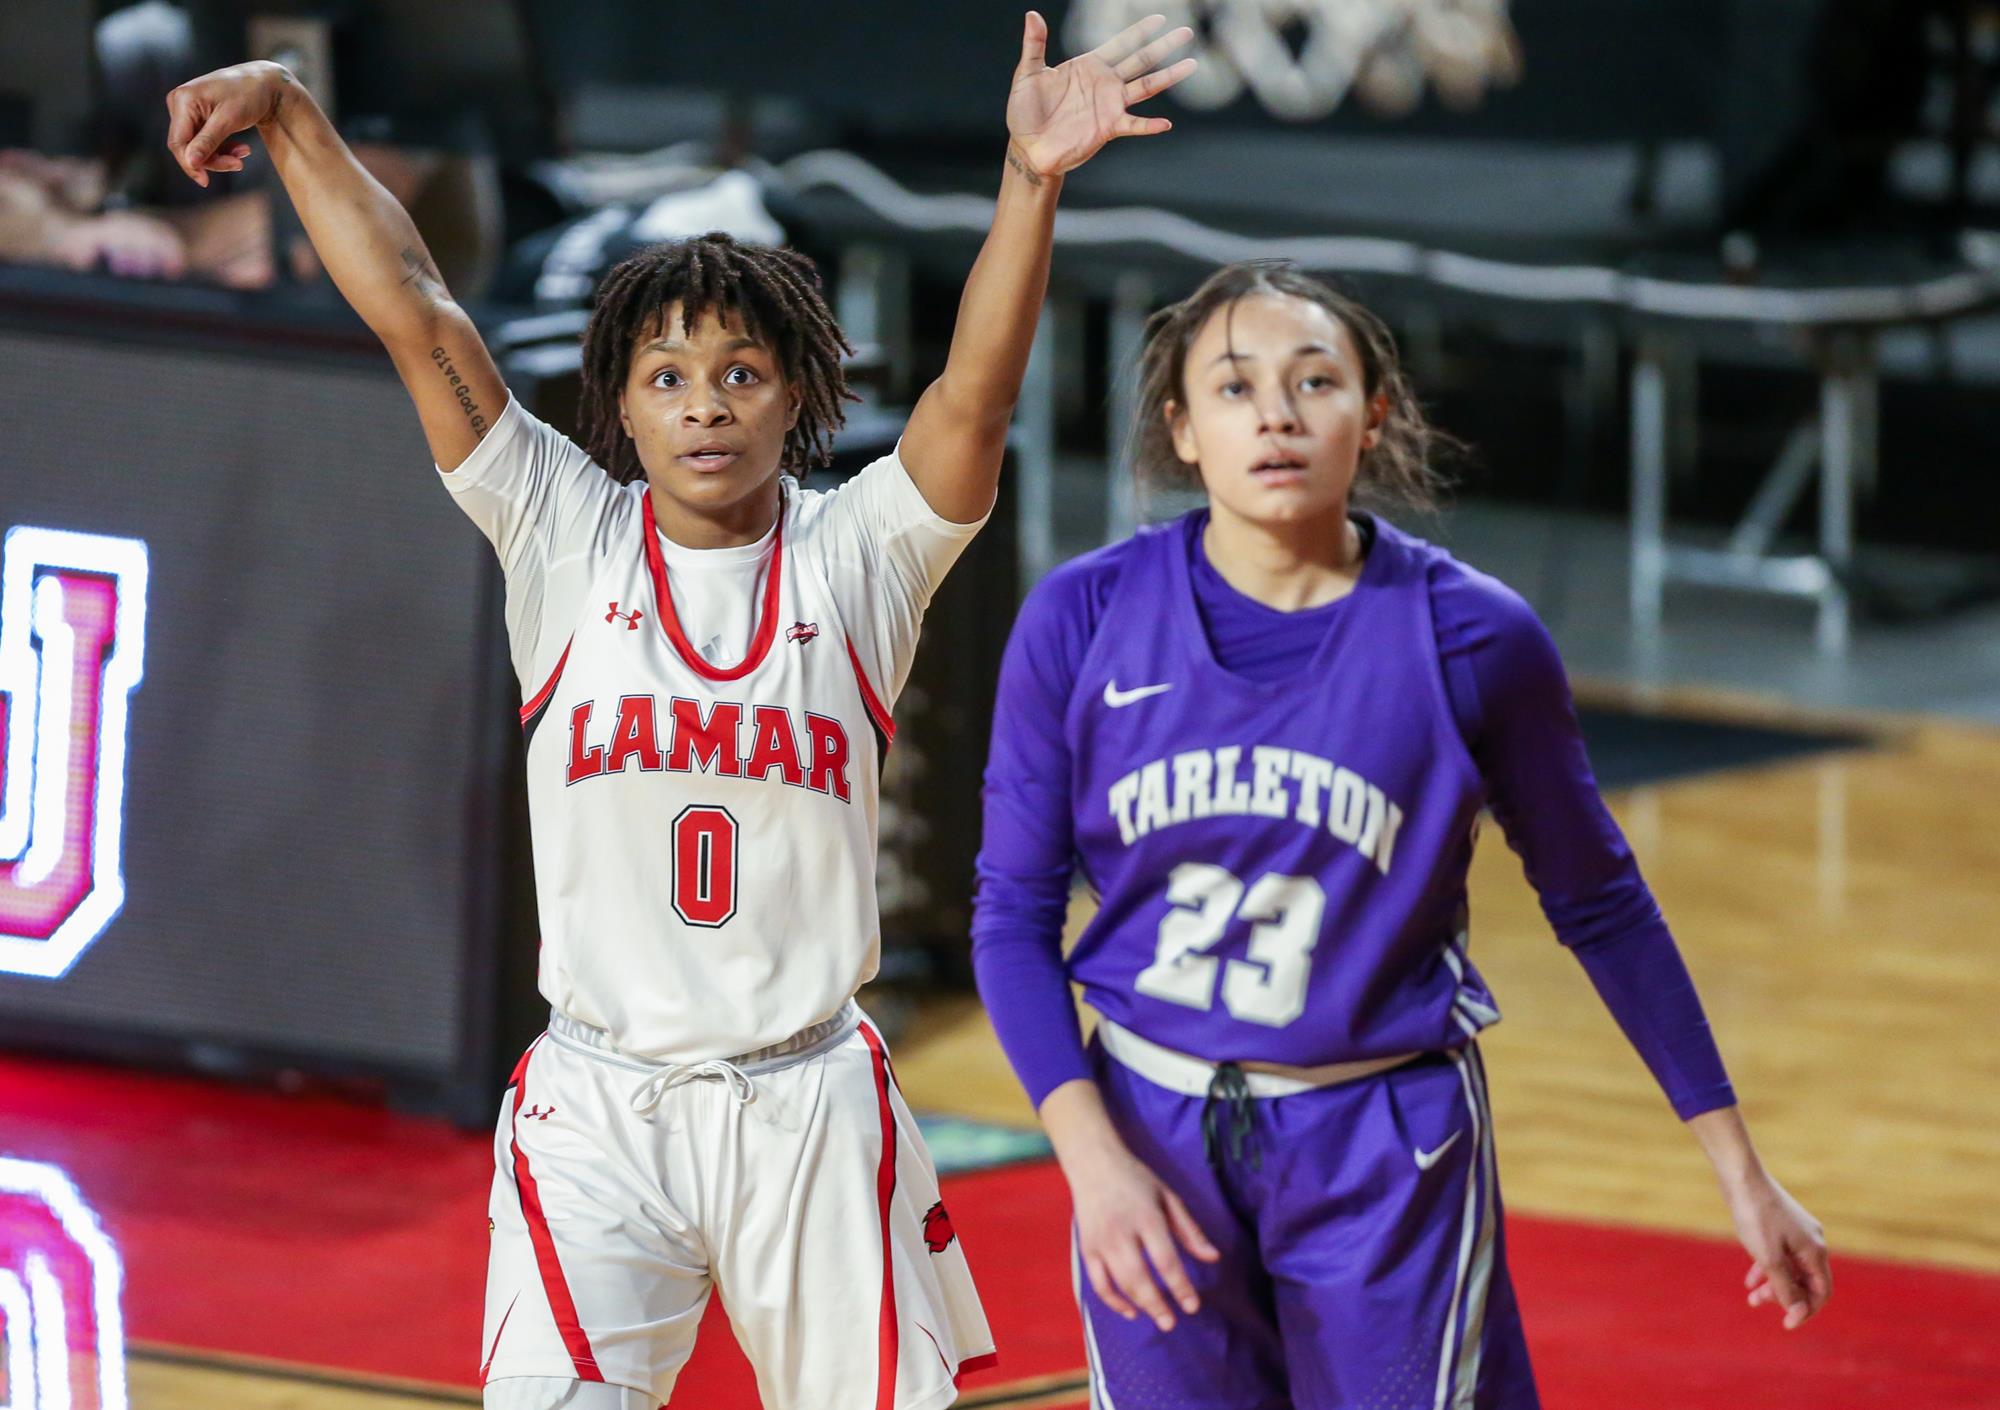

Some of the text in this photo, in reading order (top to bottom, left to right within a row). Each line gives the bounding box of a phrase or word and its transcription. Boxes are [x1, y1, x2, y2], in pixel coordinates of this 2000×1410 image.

[471, 414, 488, 442] Gl
[566, 694, 851, 804] LAMAR
[1107, 745, 1403, 876] TARLETON
[671, 804, 739, 928] 0
[1134, 862, 1326, 1028] 23
